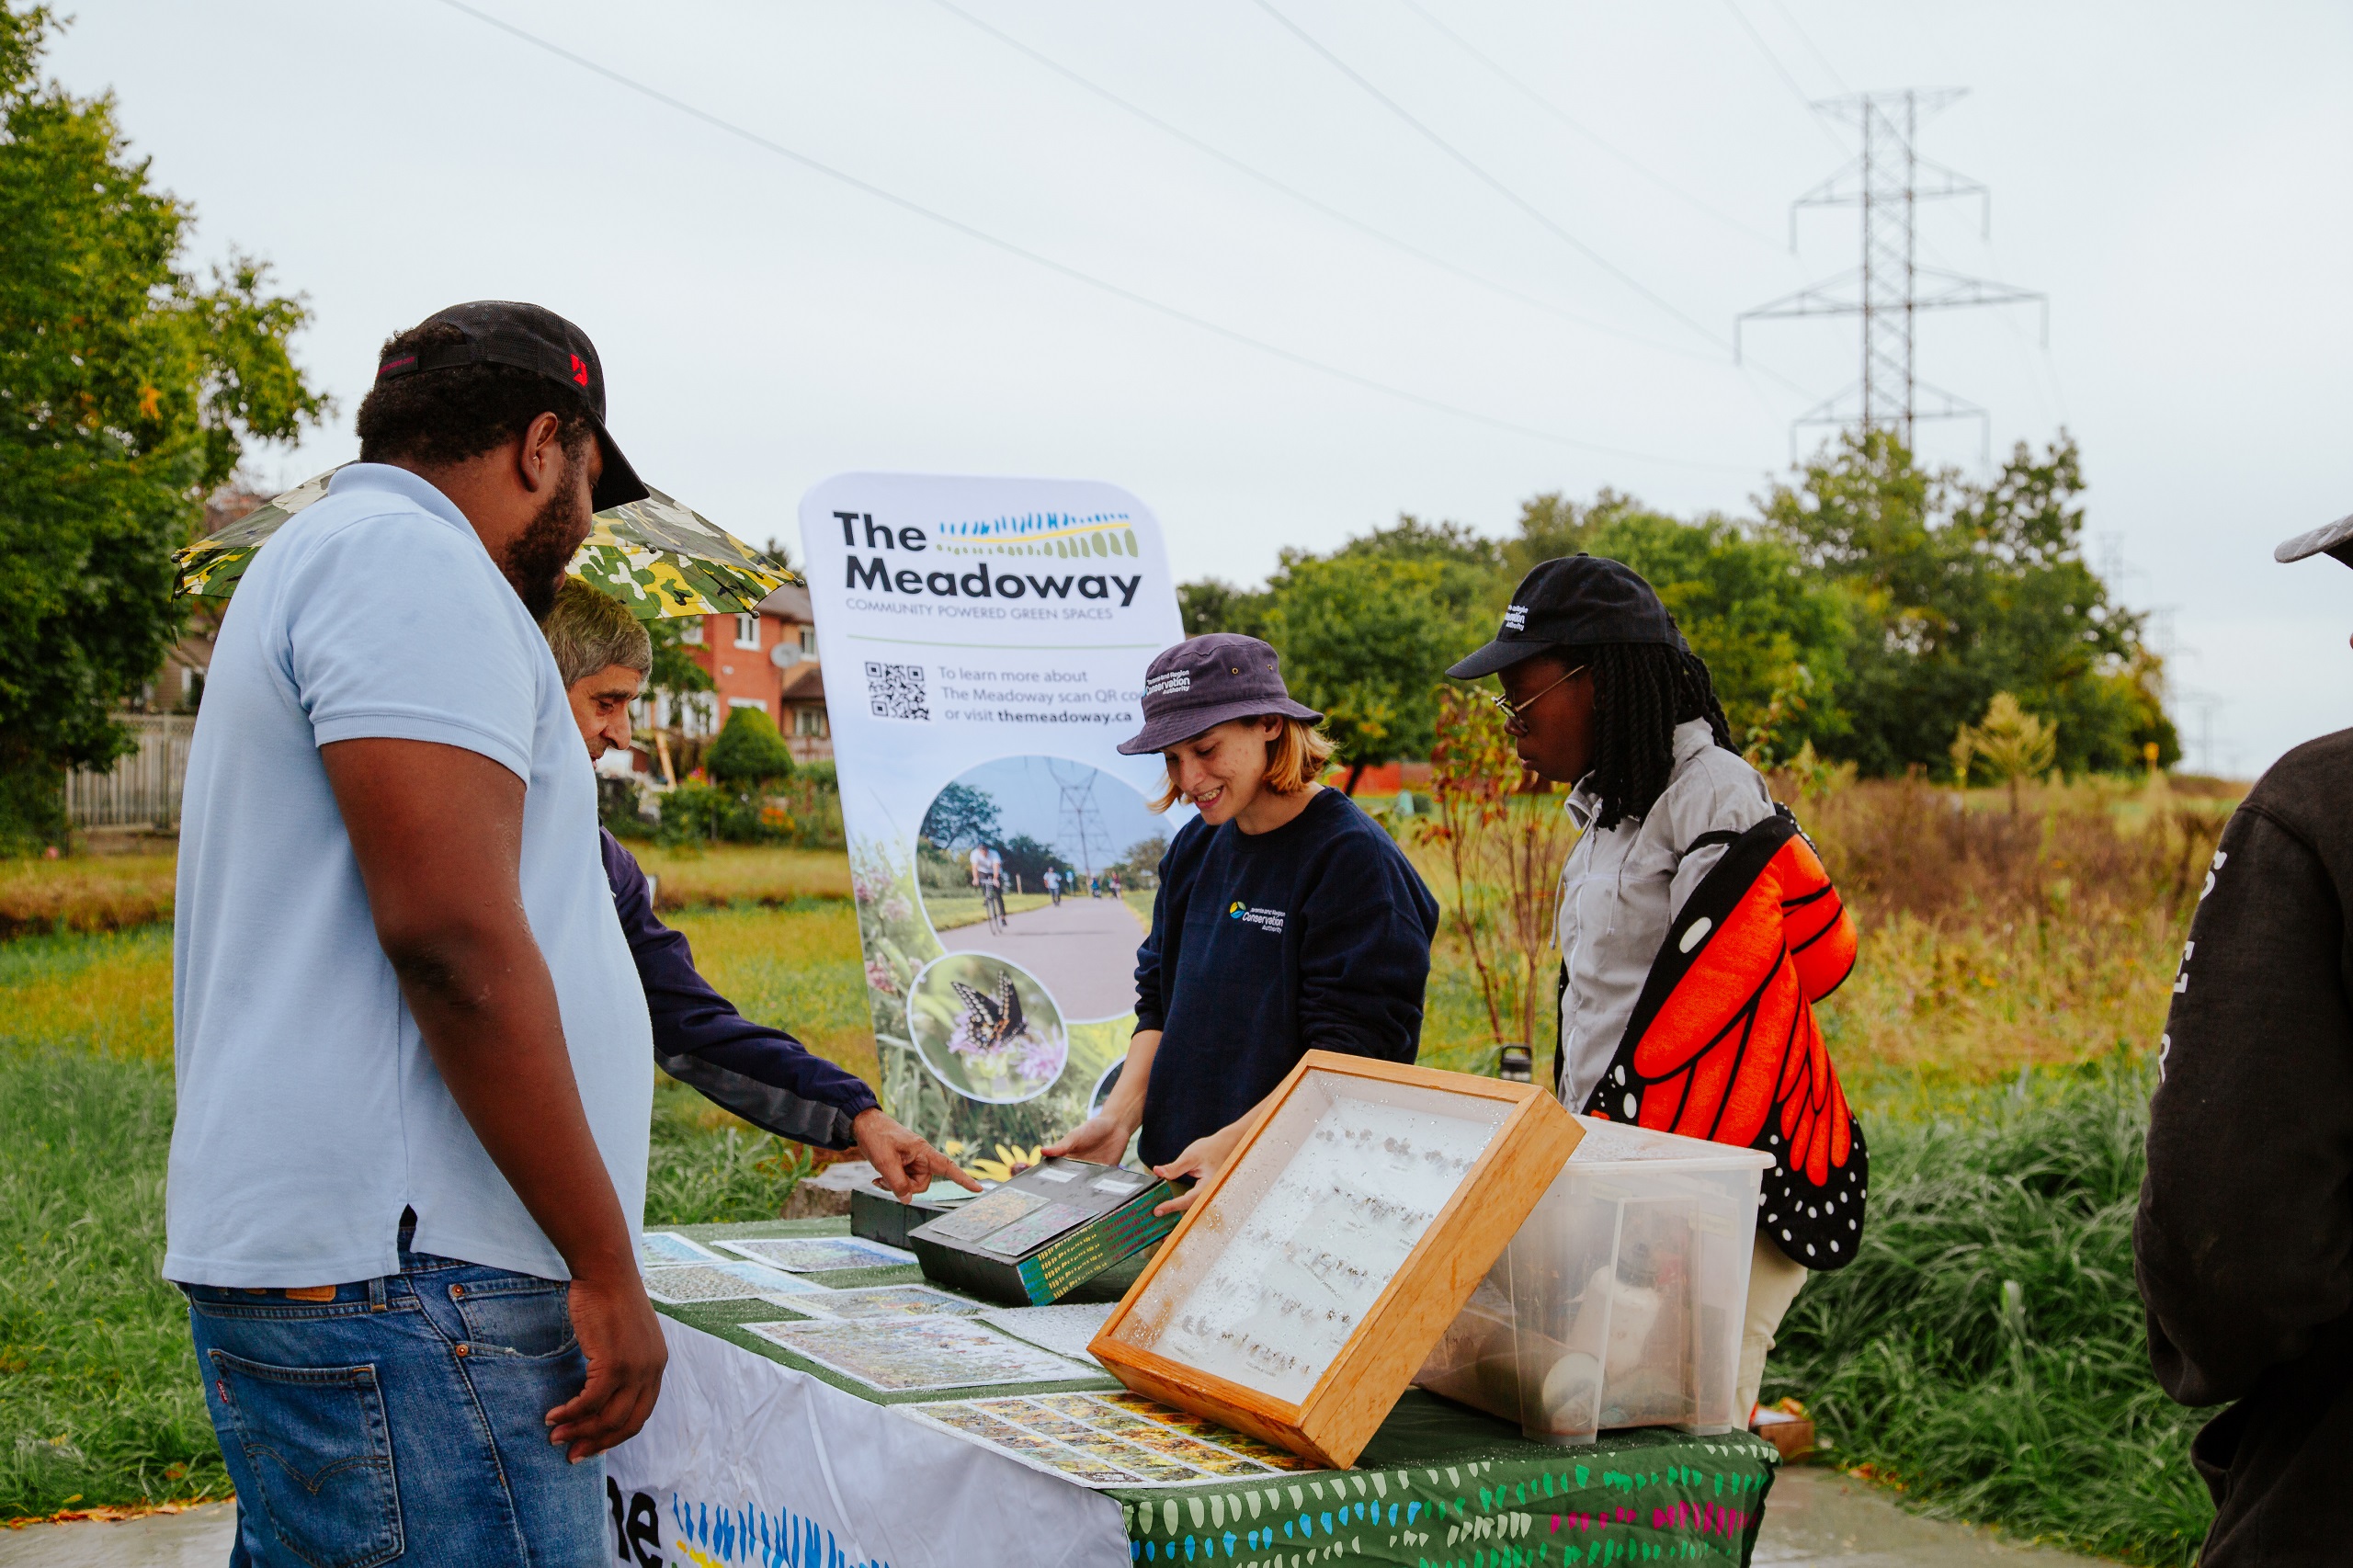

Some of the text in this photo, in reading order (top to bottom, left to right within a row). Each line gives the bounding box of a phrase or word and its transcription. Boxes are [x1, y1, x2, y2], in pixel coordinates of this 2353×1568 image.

[833, 511, 926, 551] The
[846, 555, 1142, 608] Meadoway
[846, 597, 1114, 620] COMMUNITY POWERED GREEN SPACES
[938, 666, 1088, 683] To learn more about
[1169, 670, 1190, 679] Region
[941, 687, 970, 700] The
[972, 688, 1054, 706] Meadoway
[1058, 691, 1092, 703] scan
[1095, 688, 1118, 704] QR
[1162, 686, 1190, 695] Authority
[945, 709, 1132, 726] or visit themeadoway.ca
[1243, 912, 1284, 927] Conservation
